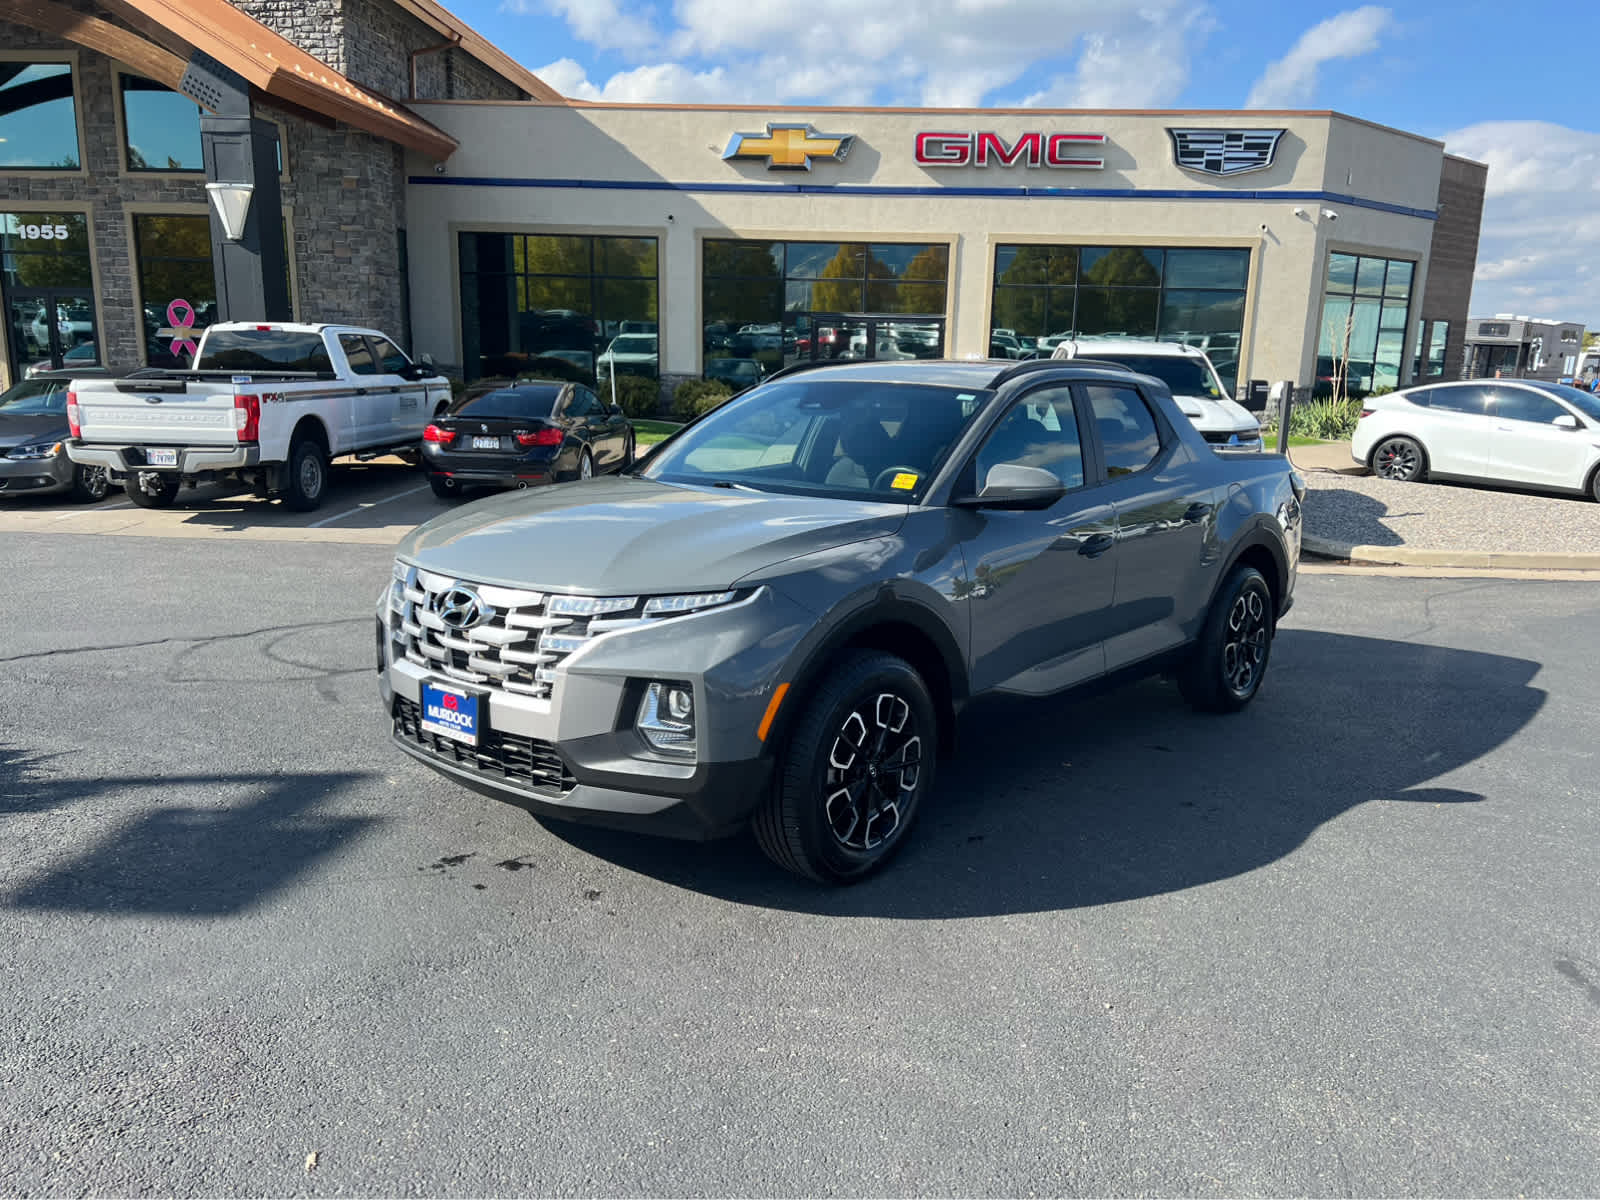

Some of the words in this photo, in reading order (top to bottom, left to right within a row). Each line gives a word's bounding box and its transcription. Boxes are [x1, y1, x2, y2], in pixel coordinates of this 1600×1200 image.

[913, 130, 1106, 169] GMC
[16, 224, 69, 240] 1955
[427, 703, 473, 729] MURDOCK
